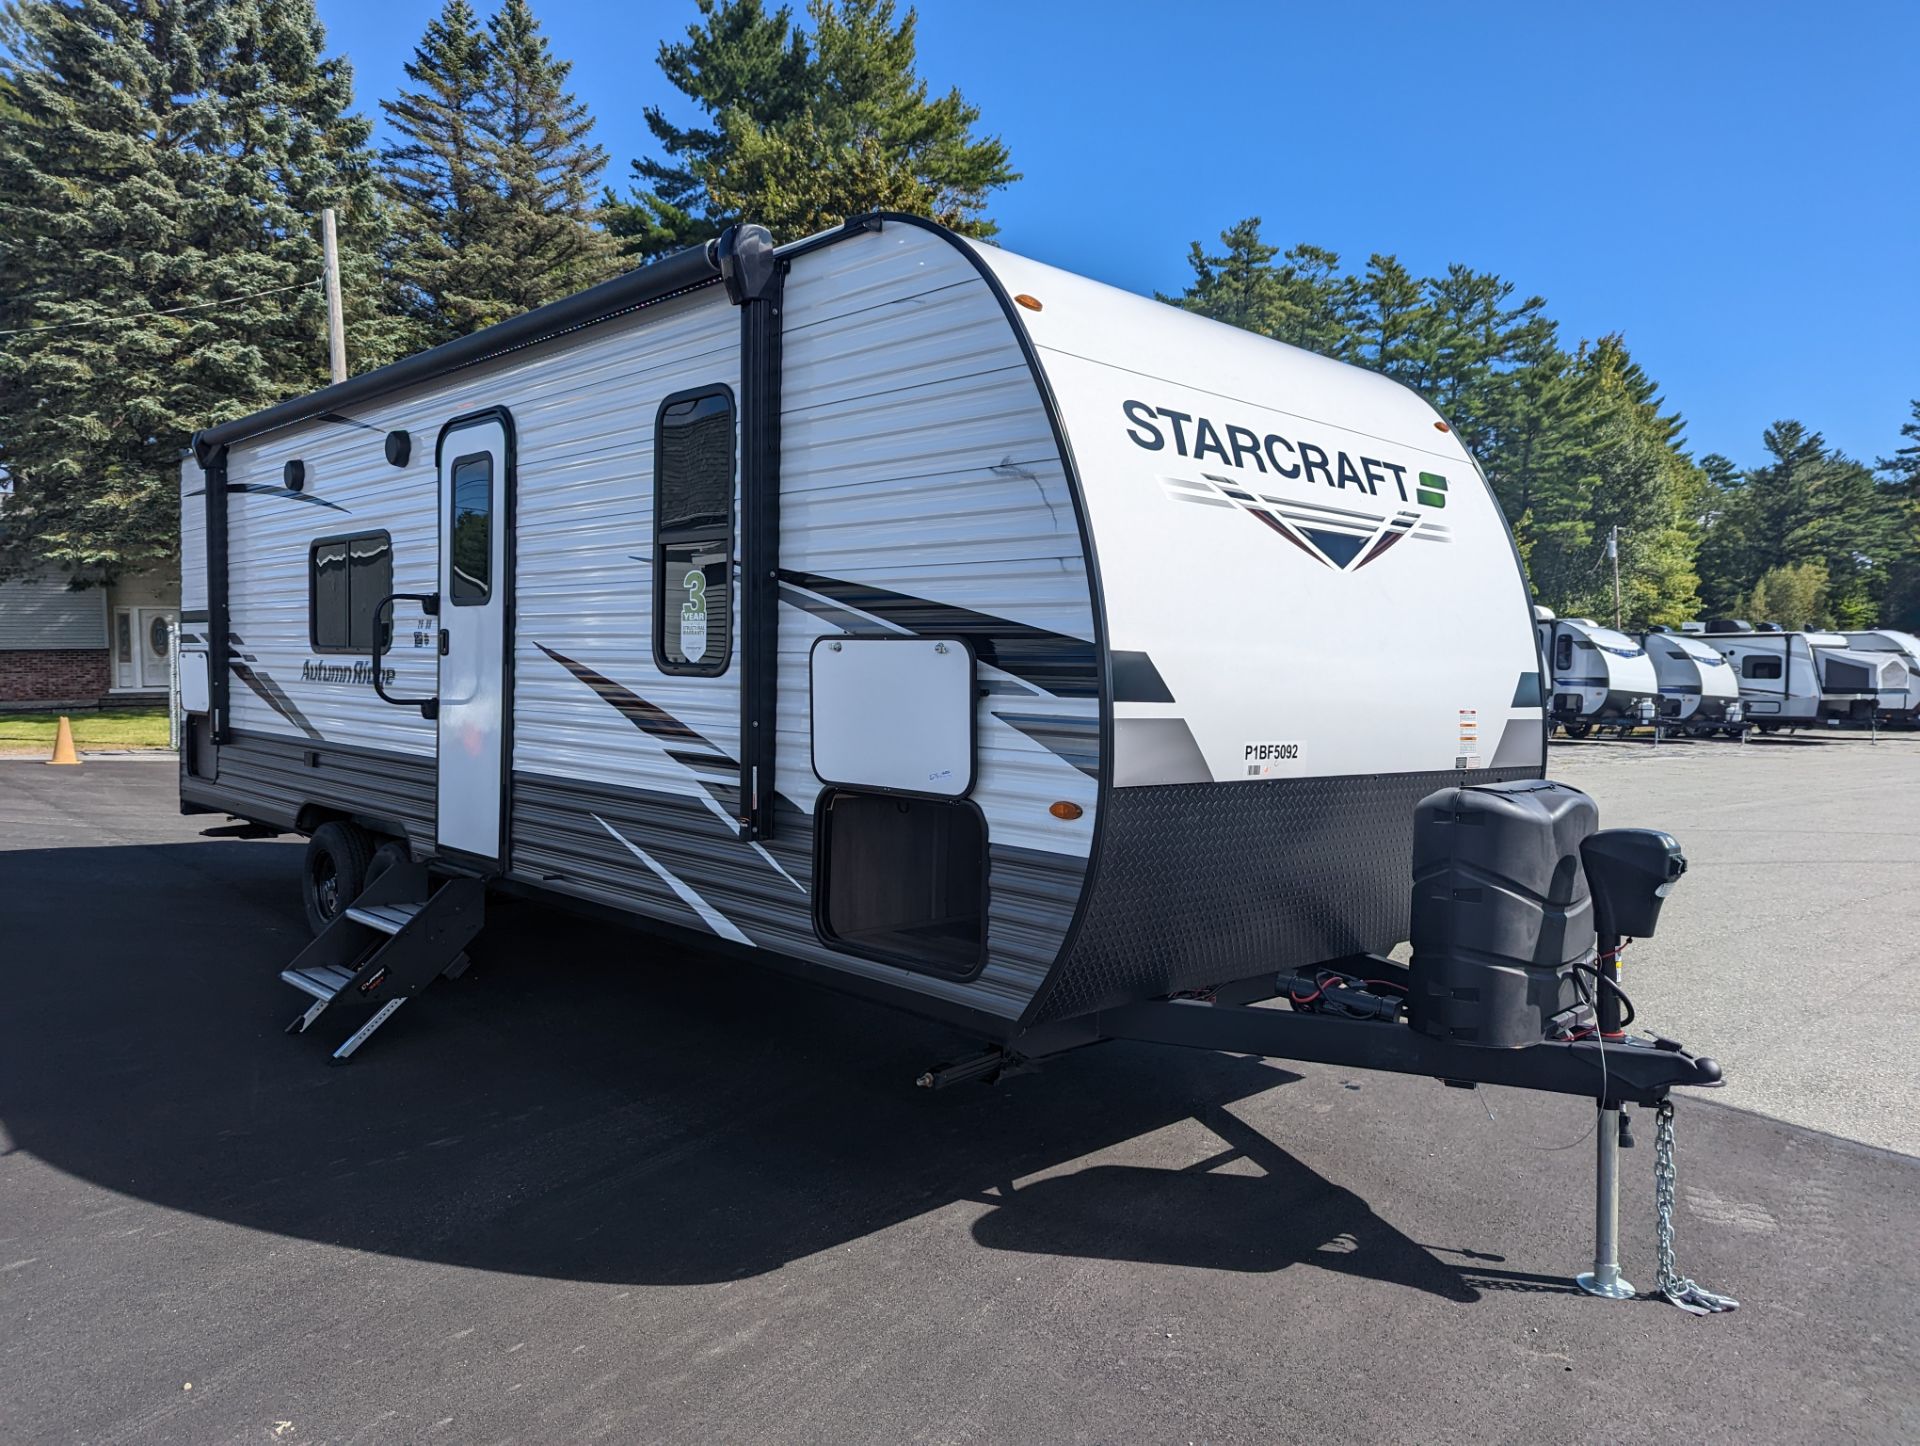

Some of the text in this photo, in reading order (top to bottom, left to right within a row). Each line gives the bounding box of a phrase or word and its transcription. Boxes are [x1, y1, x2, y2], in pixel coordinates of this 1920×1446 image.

[1122, 399, 1409, 503] STARCRAFT
[683, 570, 707, 613] 3
[683, 612, 705, 621] YEAR
[1245, 744, 1299, 761] P1BF5092
